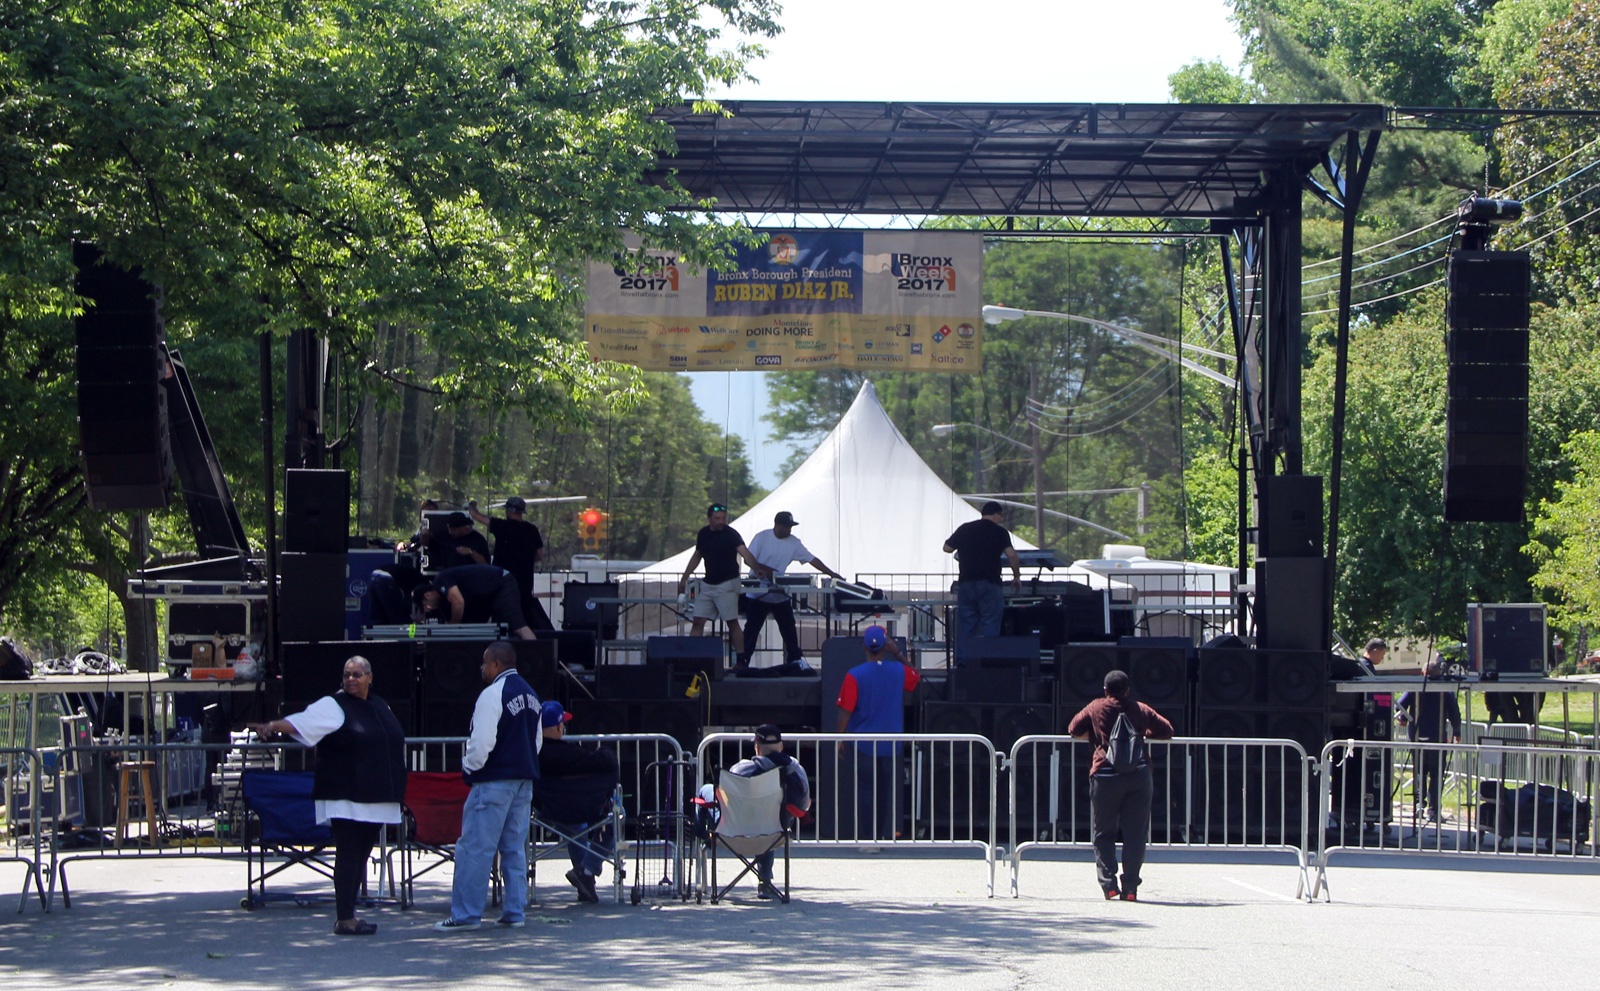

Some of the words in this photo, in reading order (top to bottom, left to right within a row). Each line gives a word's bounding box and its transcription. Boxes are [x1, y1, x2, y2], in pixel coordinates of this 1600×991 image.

[900, 253, 953, 266] Bronx
[717, 270, 749, 281] Bronx
[751, 268, 798, 281] Borough
[802, 266, 852, 279] President
[900, 265, 955, 279] Week
[620, 277, 668, 291] 2017
[897, 278, 945, 291] 2017
[714, 283, 777, 302] RUBEN
[782, 281, 827, 300] DIAZ
[830, 280, 854, 301] JR.
[746, 327, 780, 337] DOING
[783, 327, 813, 337] MORE
[605, 343, 638, 351] healthfirst
